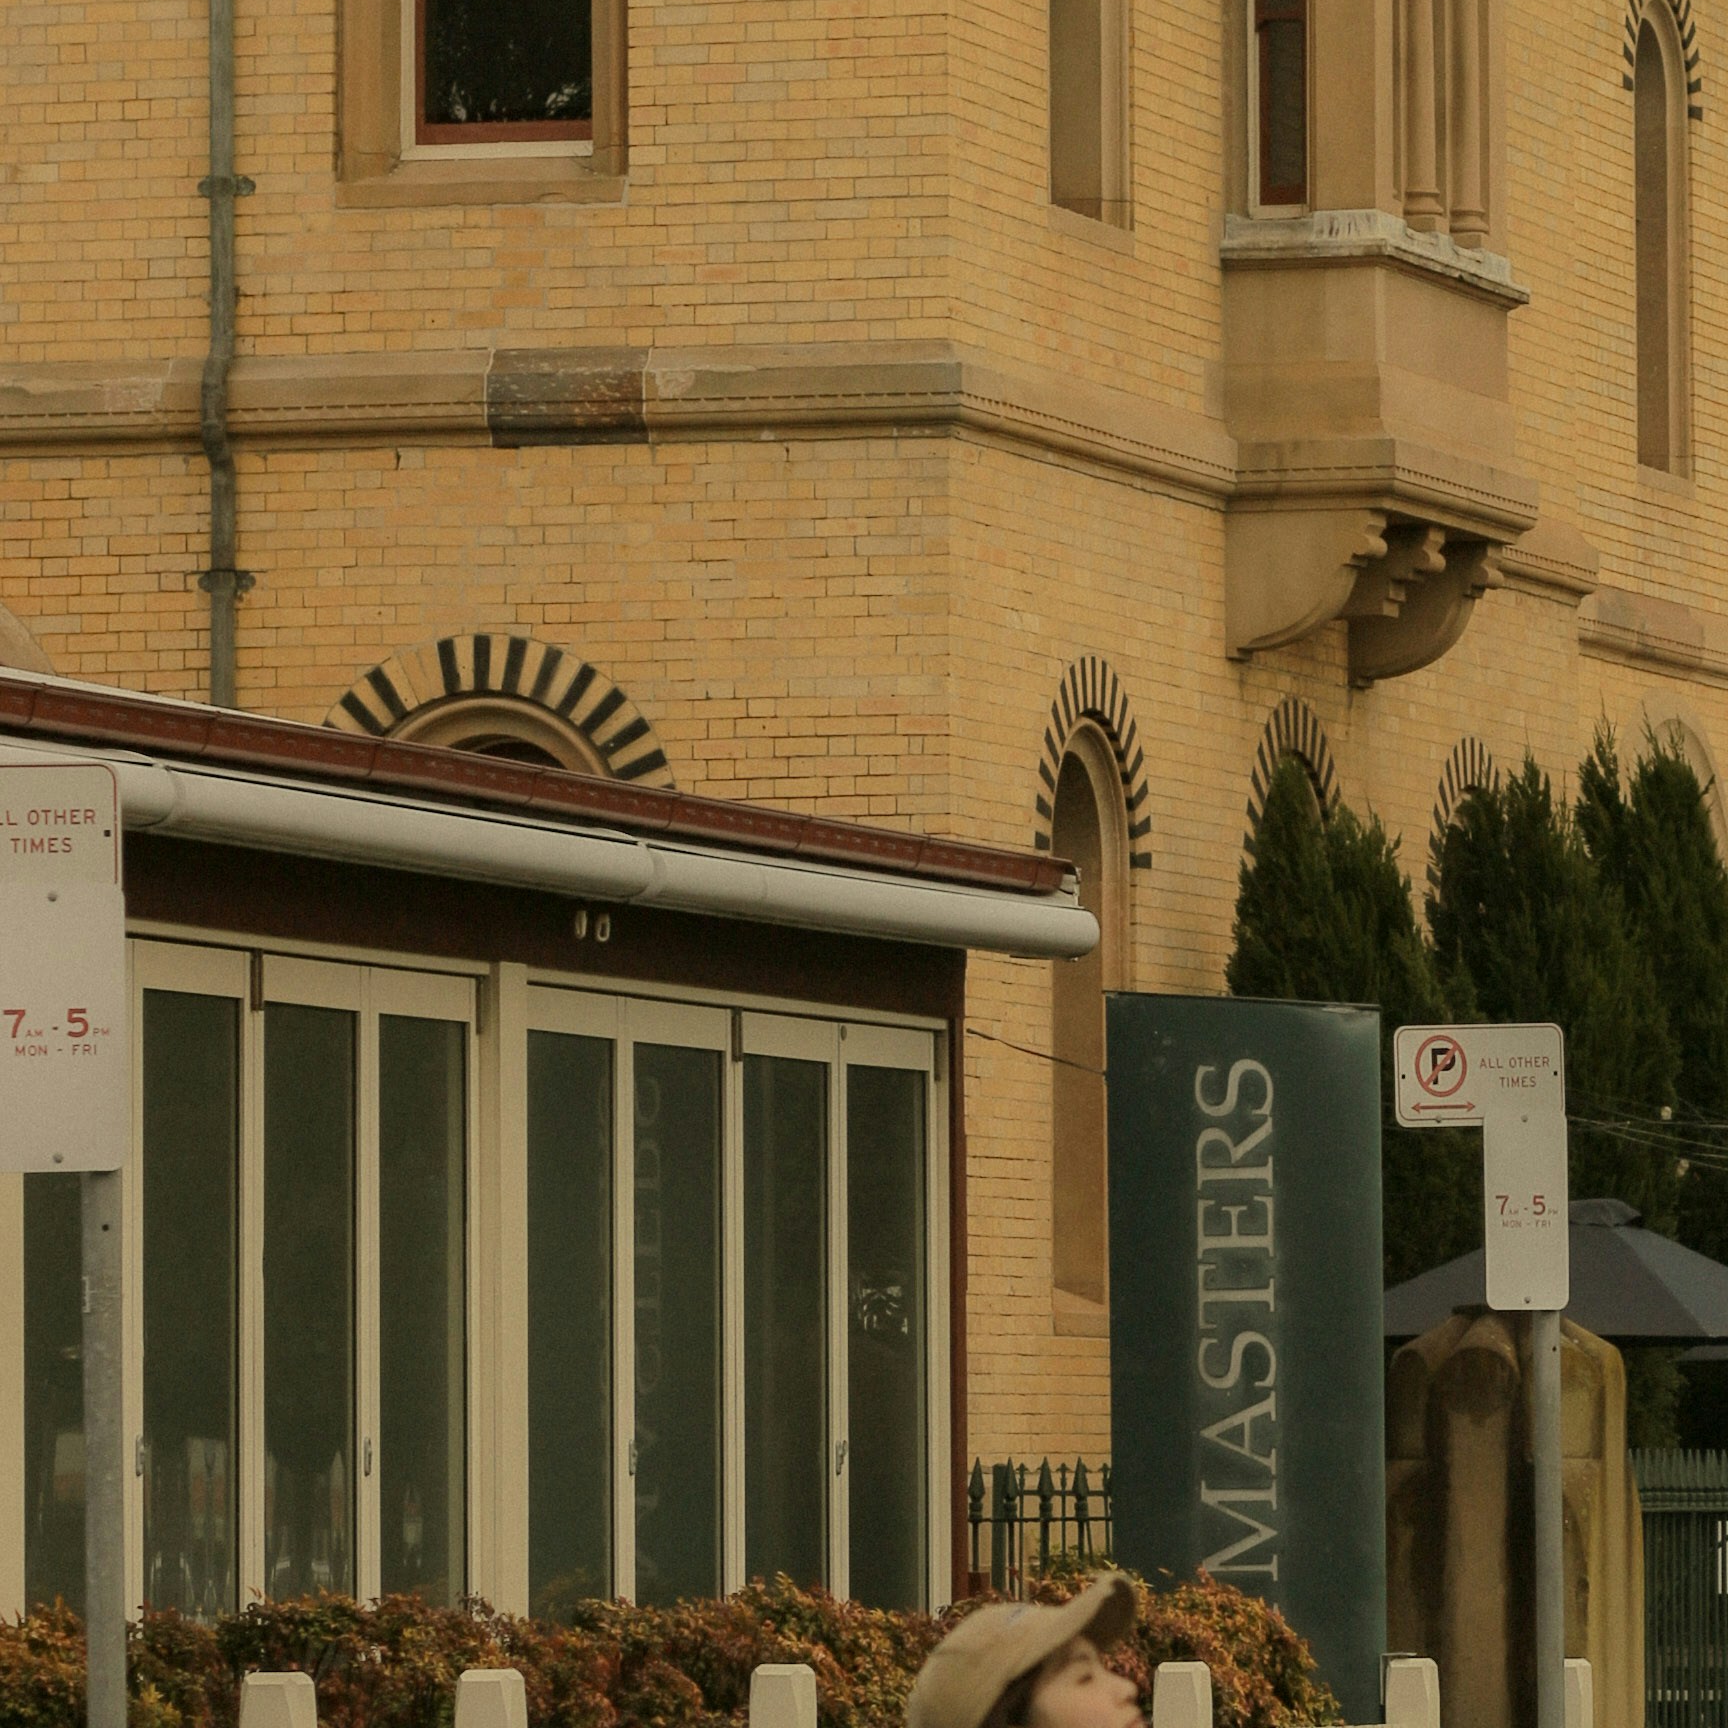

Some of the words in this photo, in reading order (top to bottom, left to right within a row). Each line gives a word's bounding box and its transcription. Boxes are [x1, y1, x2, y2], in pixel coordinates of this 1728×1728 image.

[27, 808, 97, 826] OTHER
[10, 837, 73, 854] TIMES
[15, 1044, 48, 1057] MON
[71, 1043, 97, 1056] FRI
[1479, 1058, 1504, 1070] ALL
[1508, 1056, 1551, 1069] OTHER
[1499, 1076, 1537, 1088] TIMES
[1194, 1057, 1279, 1583] MASTERS
